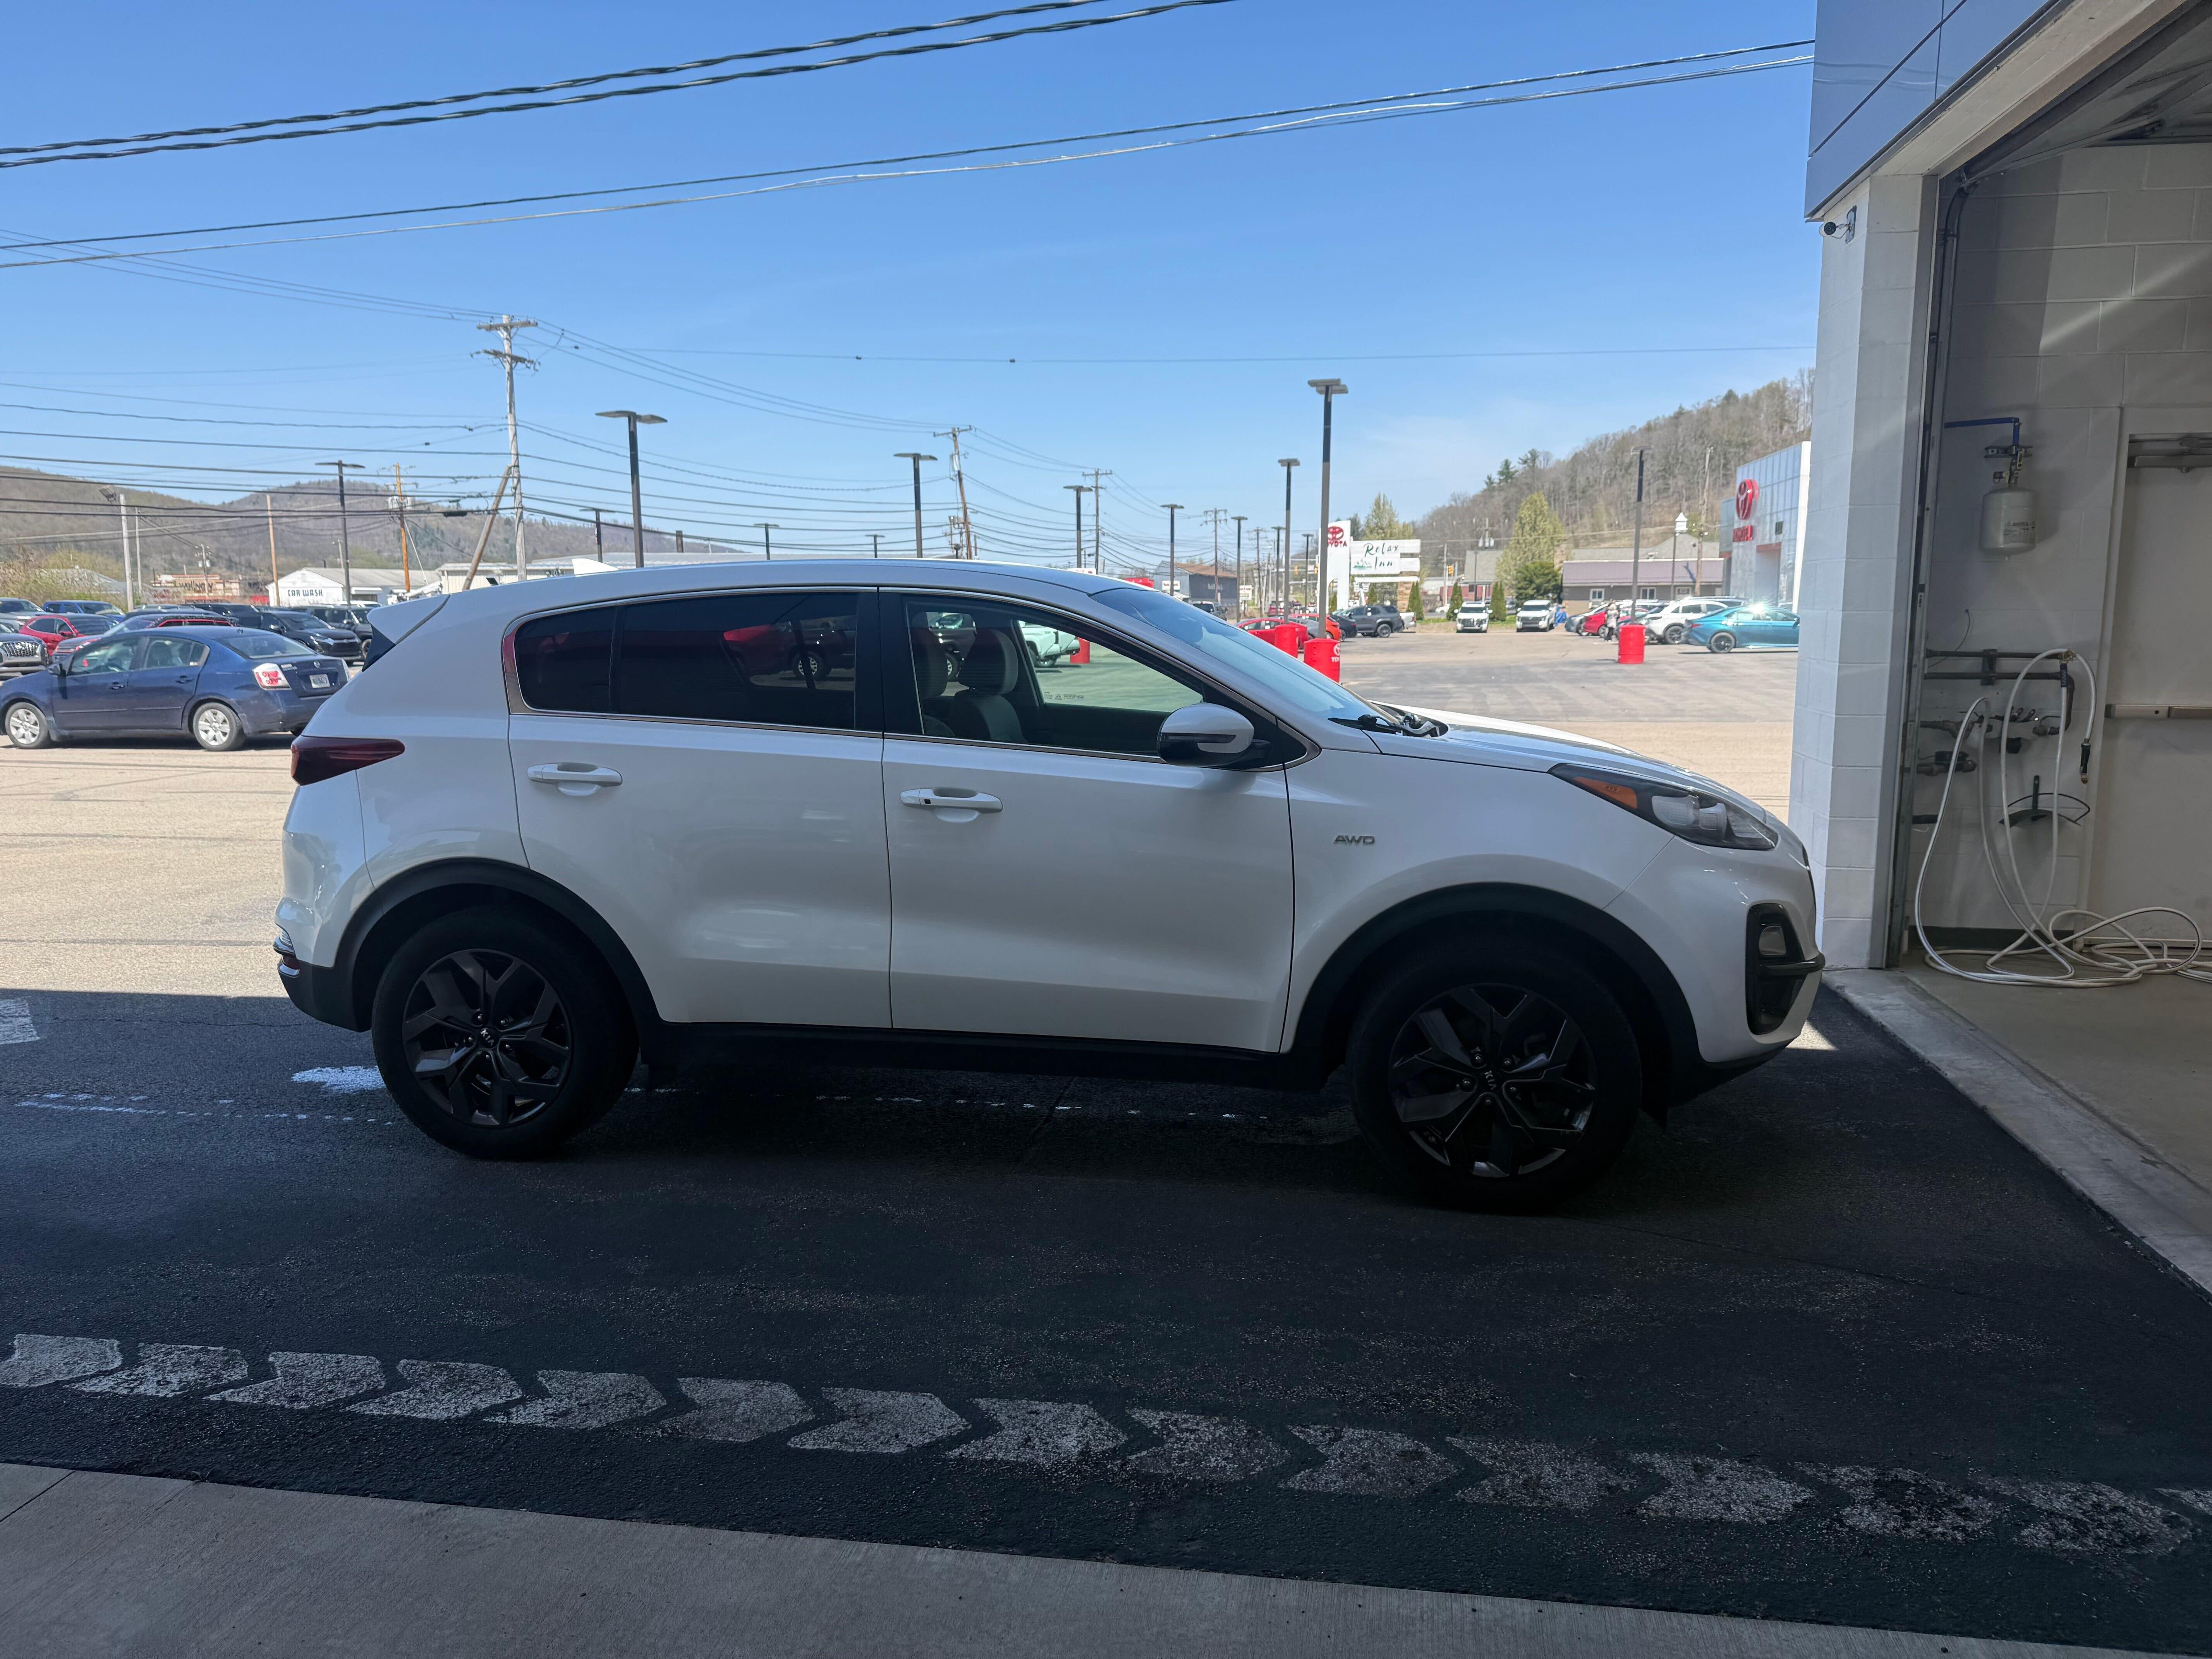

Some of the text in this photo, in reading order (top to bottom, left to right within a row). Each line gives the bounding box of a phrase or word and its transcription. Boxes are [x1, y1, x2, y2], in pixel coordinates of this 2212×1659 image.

[1364, 542, 1399, 558] Relax
[1375, 556, 1393, 570] Inn
[1334, 835, 1375, 845] AWD
[481, 1029, 494, 1046] KIA
[1484, 1070, 1497, 1091] KIA
